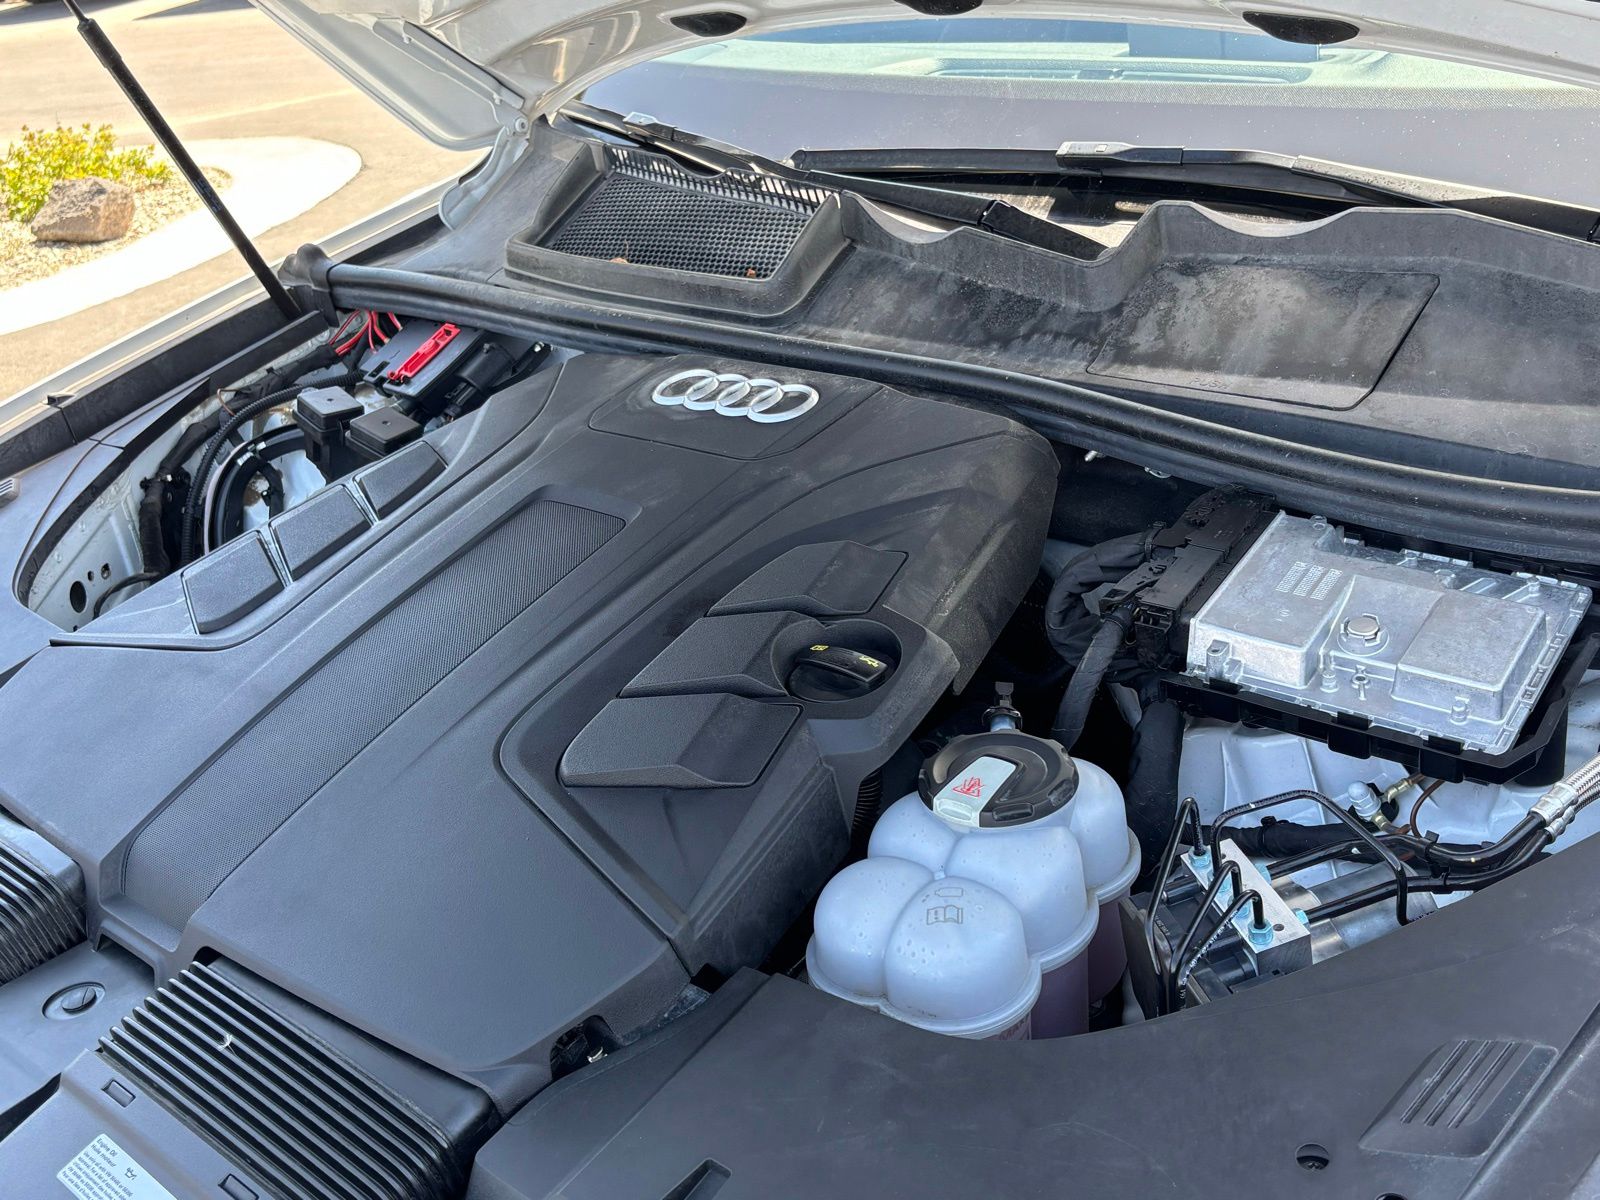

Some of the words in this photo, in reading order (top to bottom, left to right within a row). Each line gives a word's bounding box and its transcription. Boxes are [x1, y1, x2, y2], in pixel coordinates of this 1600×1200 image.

[1189, 377, 1231, 390] PUSH
[95, 1137, 111, 1152] Engine
[99, 1151, 116, 1168] moteur
